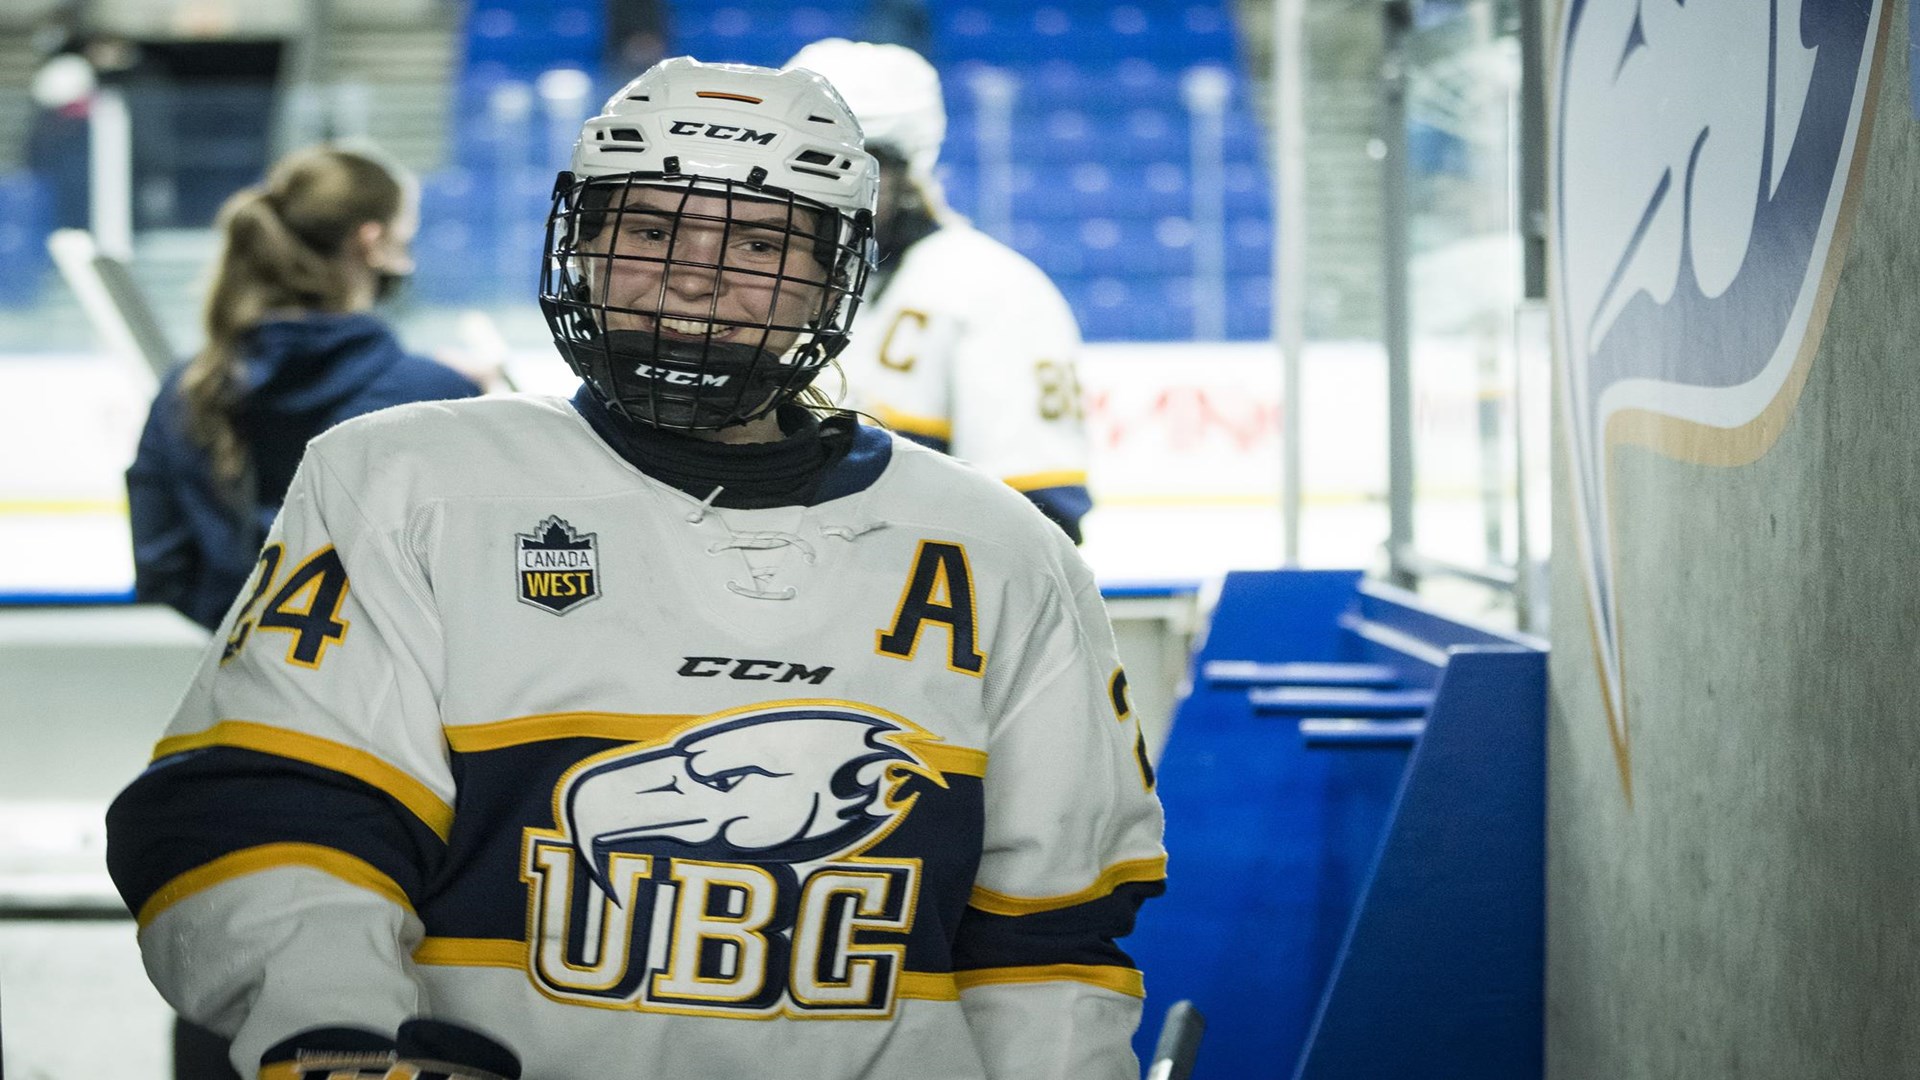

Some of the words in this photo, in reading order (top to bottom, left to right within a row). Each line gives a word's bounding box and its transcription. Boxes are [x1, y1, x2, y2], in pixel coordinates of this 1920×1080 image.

[669, 120, 777, 145] CCM
[878, 308, 928, 373] C
[634, 363, 730, 387] CCM
[525, 551, 590, 568] CANADA
[526, 572, 590, 597] WEST
[875, 539, 986, 678] A
[677, 656, 833, 685] CCM
[519, 827, 923, 1021] UBC
